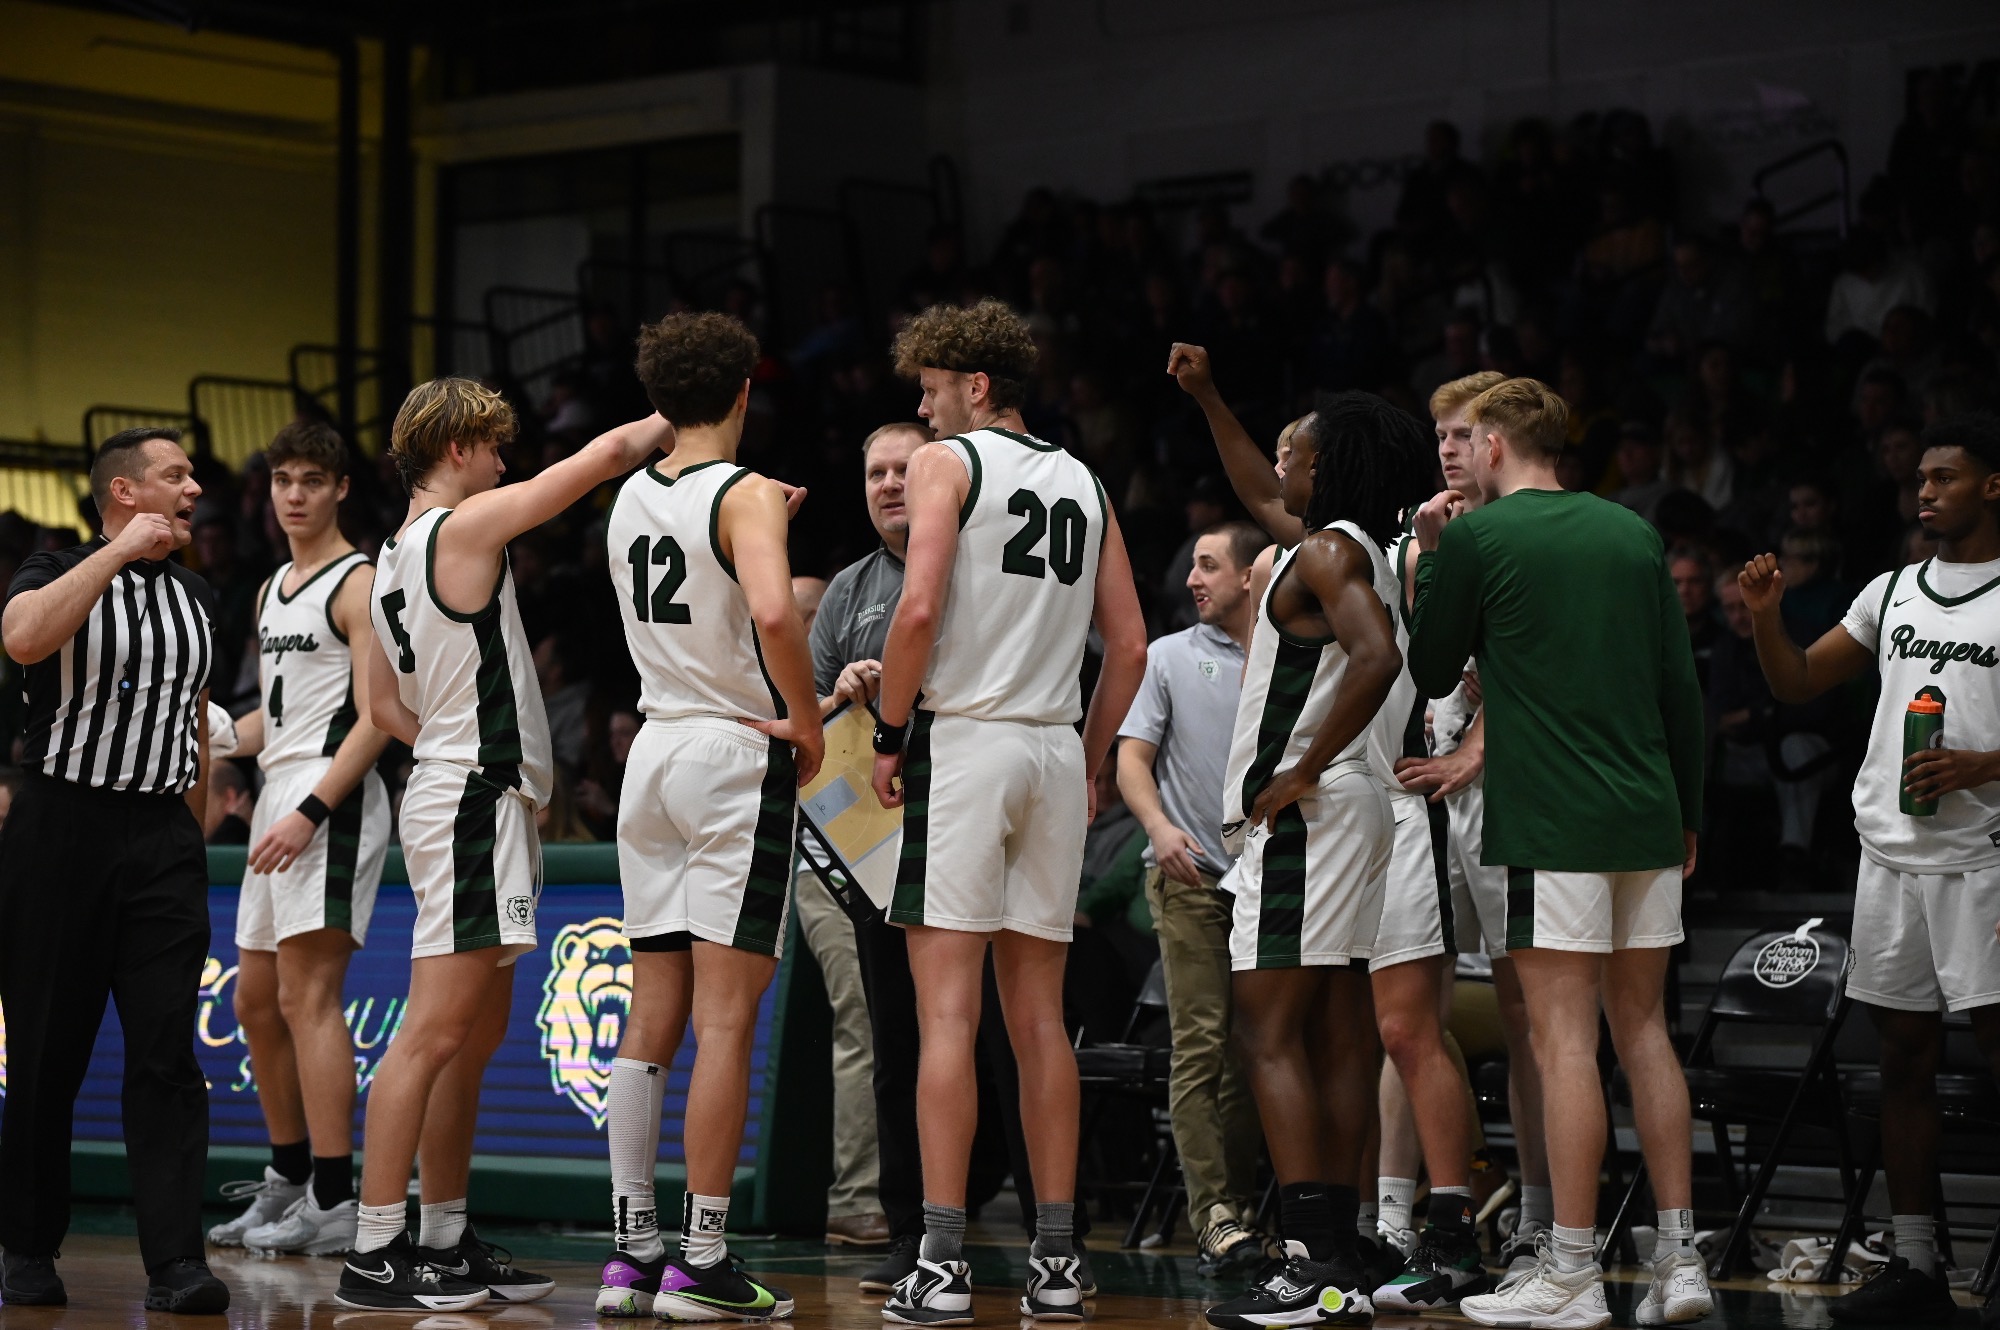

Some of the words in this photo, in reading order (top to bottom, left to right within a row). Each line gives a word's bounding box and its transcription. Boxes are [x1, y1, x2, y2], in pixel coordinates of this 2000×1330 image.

[1002, 488, 1087, 586] 20
[628, 534, 692, 624] 12
[259, 626, 319, 665] Rangers
[381, 588, 415, 673] 5
[1888, 624, 2000, 675] Rangers
[1766, 943, 1813, 962] Jersey
